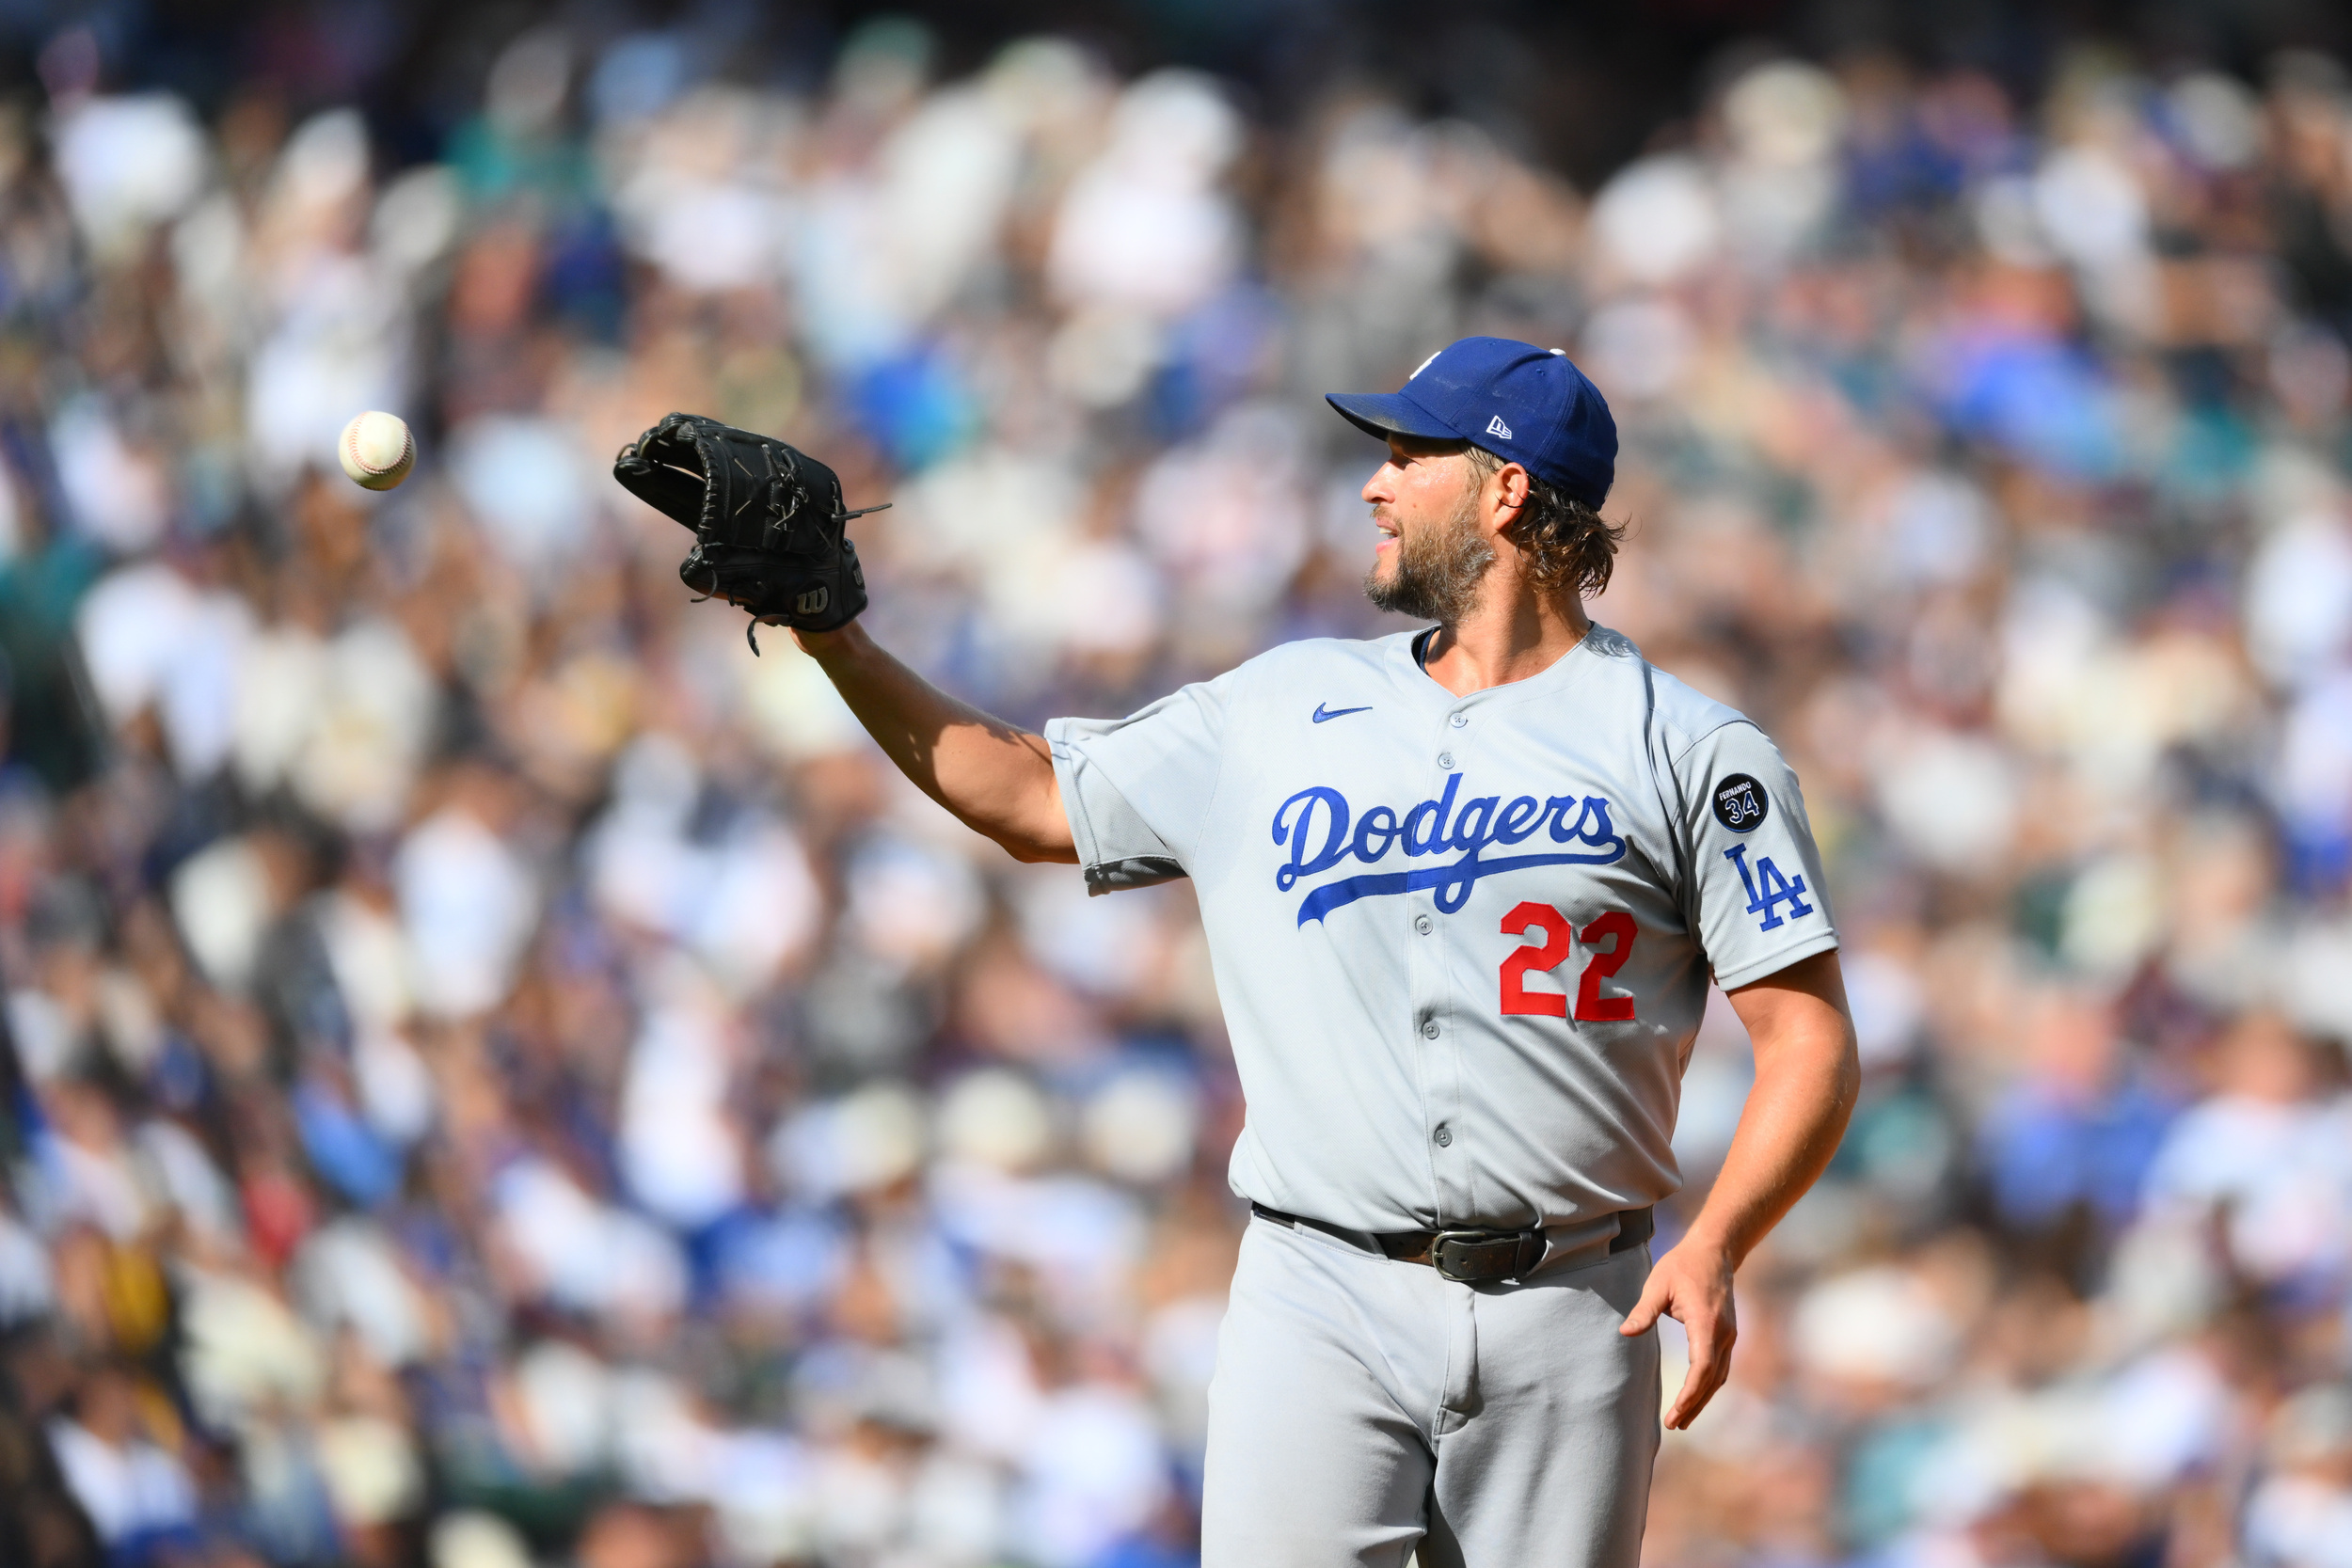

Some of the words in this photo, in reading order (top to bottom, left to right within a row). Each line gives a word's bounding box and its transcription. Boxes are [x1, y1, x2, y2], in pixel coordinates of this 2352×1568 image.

[1719, 782, 1752, 800] FERNANDO
[1724, 791, 1759, 824] 34
[1272, 772, 1626, 915] Dodgers
[1724, 843, 1814, 932] LA
[1500, 901, 1638, 1022] 22
